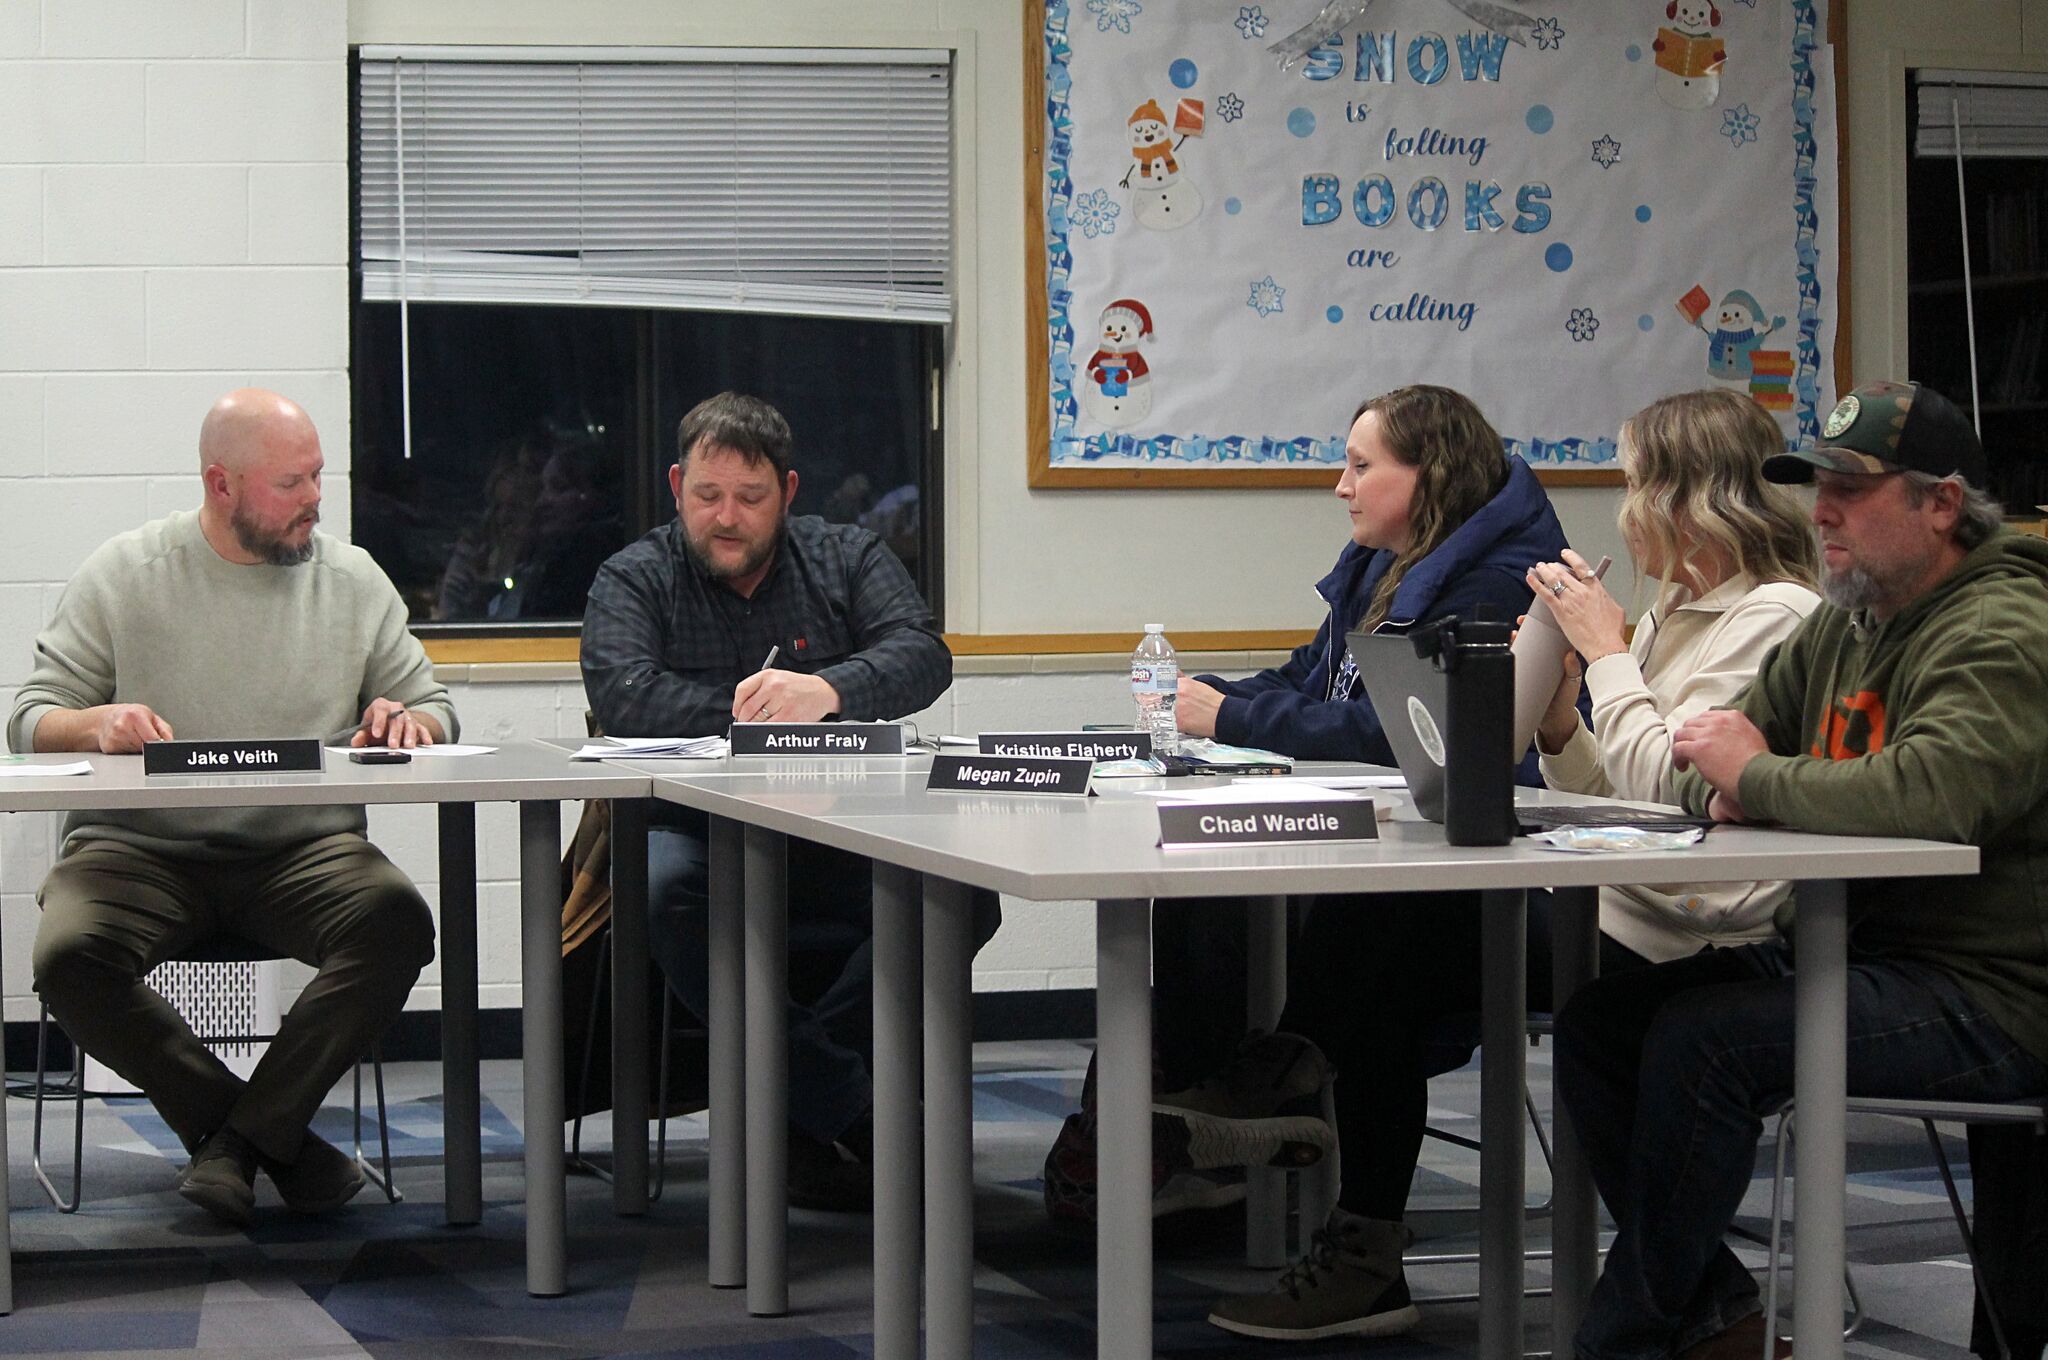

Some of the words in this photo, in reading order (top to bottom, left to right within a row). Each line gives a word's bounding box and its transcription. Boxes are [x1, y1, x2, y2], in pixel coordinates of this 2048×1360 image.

[1301, 29, 1509, 85] SNOW
[1346, 101, 1372, 122] is
[1384, 127, 1490, 166] falling
[1302, 173, 1552, 234] BOOKS
[1347, 248, 1400, 268] are
[1369, 293, 1479, 331] calling
[764, 733, 821, 748] Arthur
[825, 733, 868, 751] Fraly
[994, 744, 1062, 757] Kristine
[1067, 743, 1138, 759] Flaherty
[187, 750, 230, 765] Jake
[233, 749, 279, 764] Veith
[957, 765, 1012, 785] Megan
[1014, 767, 1061, 787] Zupin
[1200, 815, 1258, 834] Chad
[1263, 813, 1339, 832] Wardie
